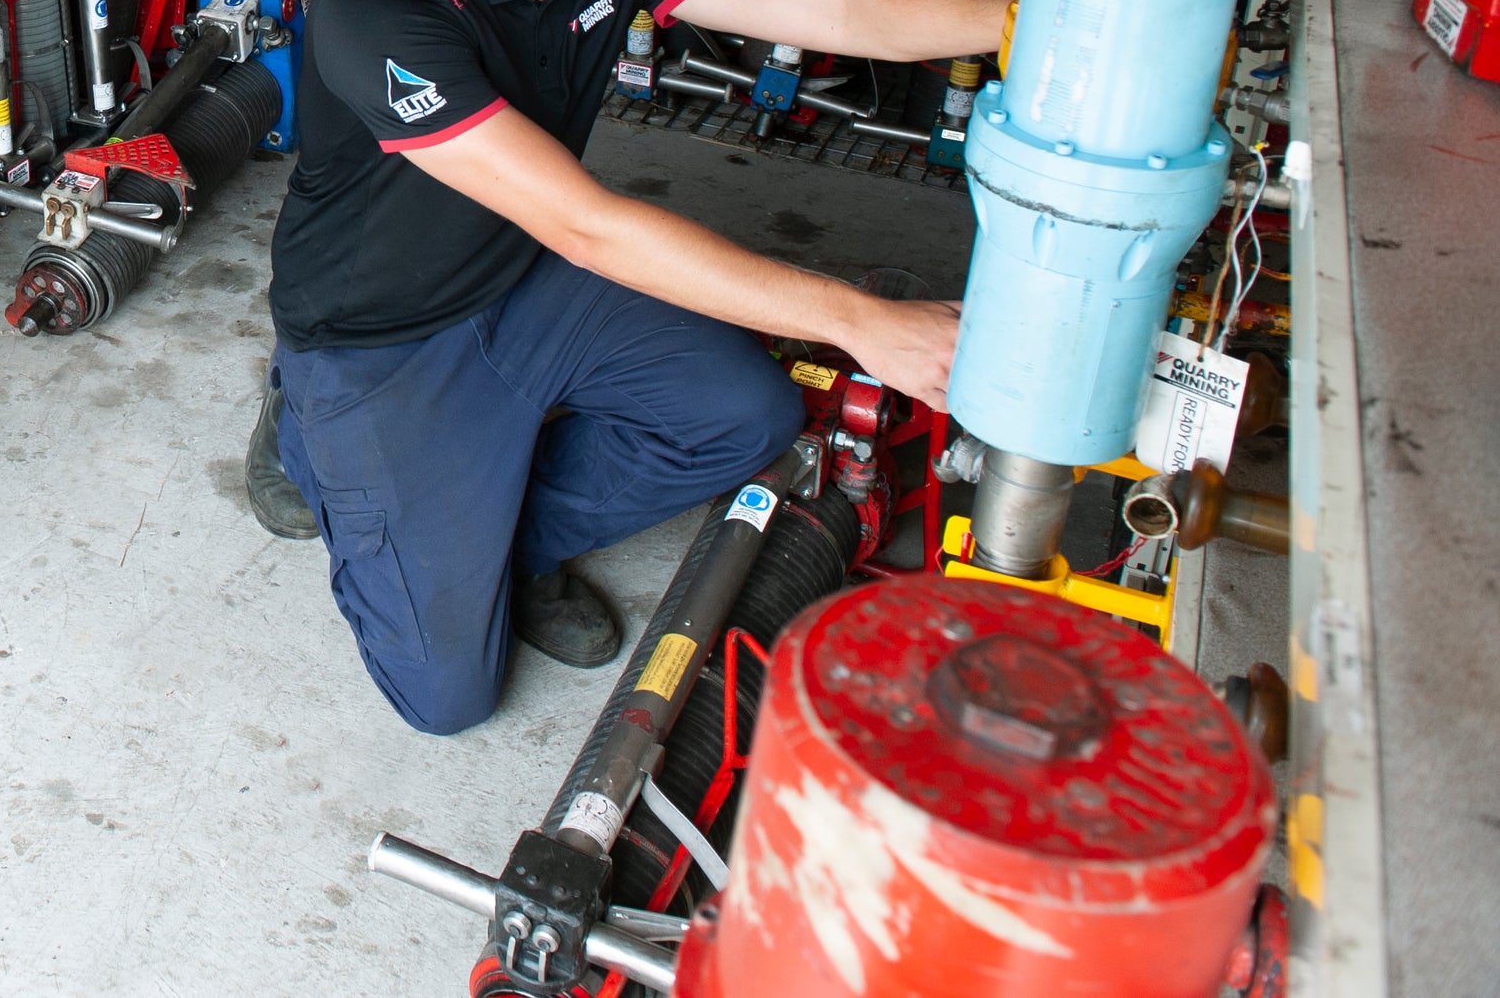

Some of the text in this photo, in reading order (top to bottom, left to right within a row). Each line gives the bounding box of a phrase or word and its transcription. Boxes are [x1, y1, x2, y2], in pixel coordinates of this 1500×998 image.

[582, 4, 615, 32] MINING
[392, 87, 443, 119] ELITE
[797, 378, 822, 388] POINT
[799, 372, 825, 383] PINCH
[1170, 368, 1229, 399] MINING
[1172, 358, 1240, 391] QUARRY
[1171, 397, 1198, 471] READY FOR
